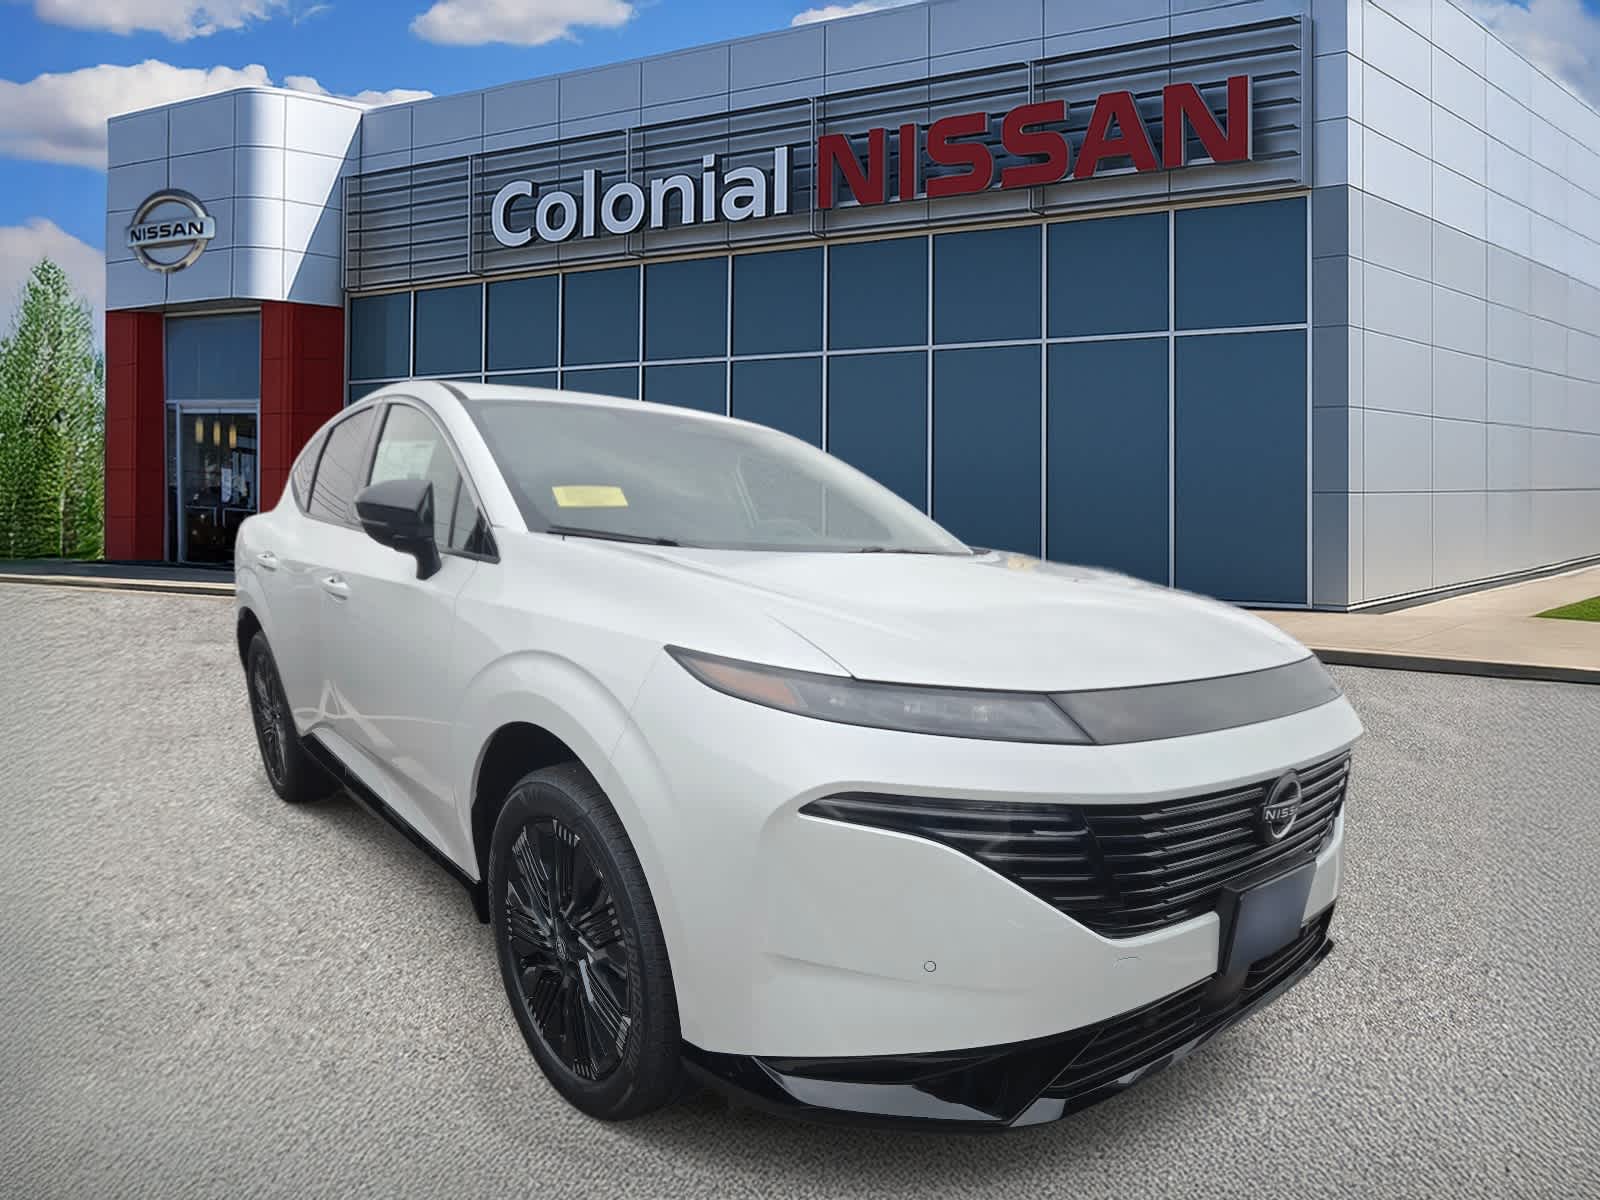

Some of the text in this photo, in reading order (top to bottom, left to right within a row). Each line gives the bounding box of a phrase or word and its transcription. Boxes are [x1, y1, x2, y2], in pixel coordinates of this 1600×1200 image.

[490, 75, 1253, 248] Colonial NISSAN
[130, 222, 204, 242] NISSAN
[1265, 806, 1298, 820] NISS
